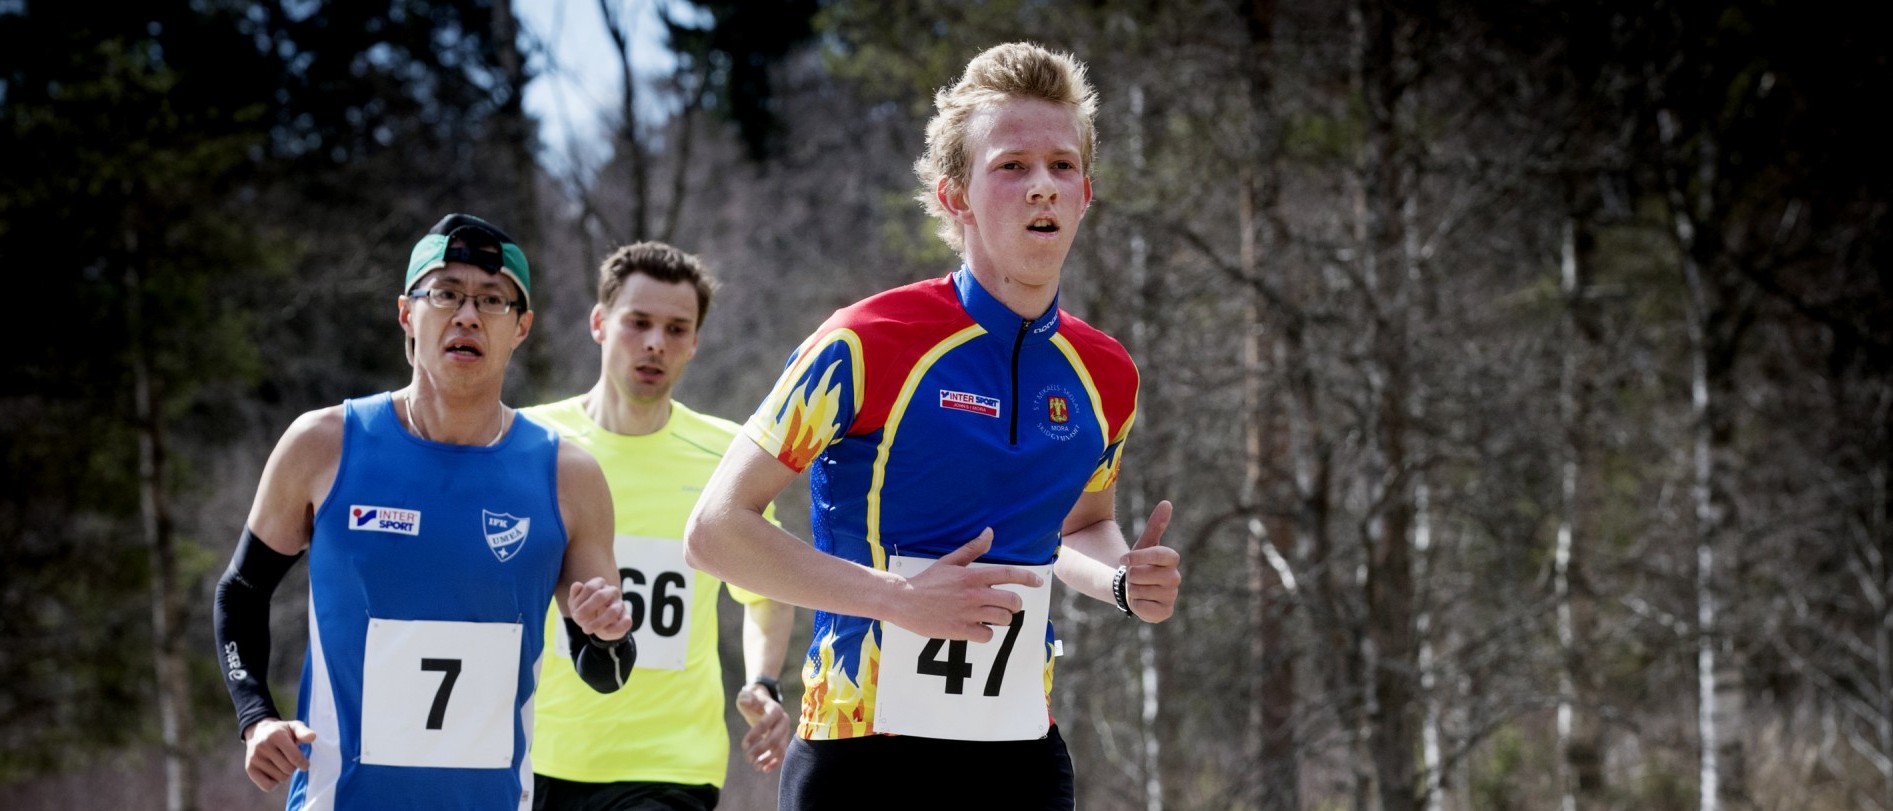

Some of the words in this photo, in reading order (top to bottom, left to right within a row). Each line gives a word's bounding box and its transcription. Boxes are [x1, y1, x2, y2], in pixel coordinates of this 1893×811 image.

[949, 392, 975, 403] INTER
[975, 396, 999, 407] SPORT
[379, 509, 415, 522] INTER
[488, 517, 509, 529] IFK
[379, 520, 415, 532] SPORT
[491, 528, 523, 547] UMEÅ
[916, 609, 1026, 697] 47
[420, 657, 463, 730] 7
